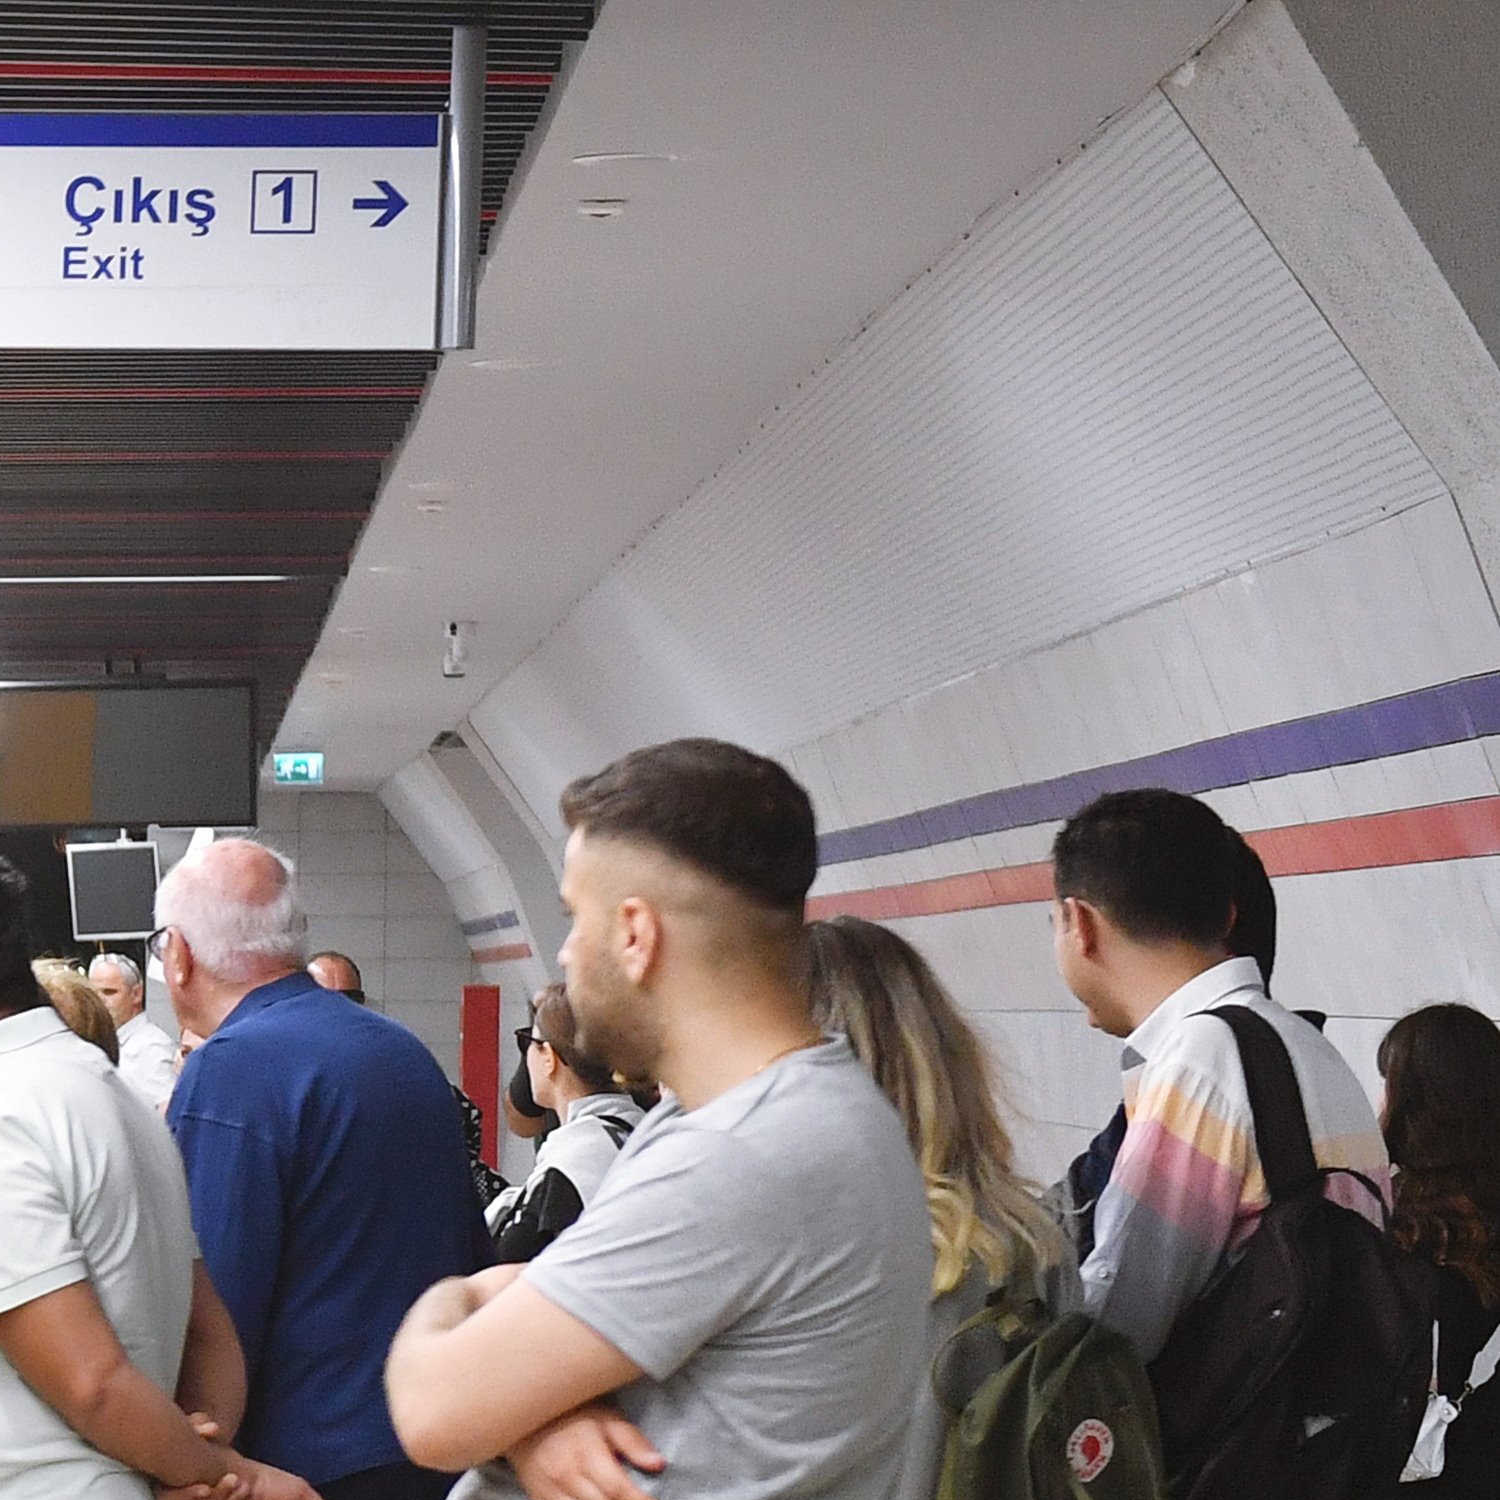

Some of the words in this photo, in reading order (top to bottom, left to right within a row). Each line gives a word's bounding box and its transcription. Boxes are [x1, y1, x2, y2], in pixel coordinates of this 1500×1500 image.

[64, 175, 217, 237] Çıkış
[270, 176, 294, 225] 1
[62, 246, 145, 280] Exit
